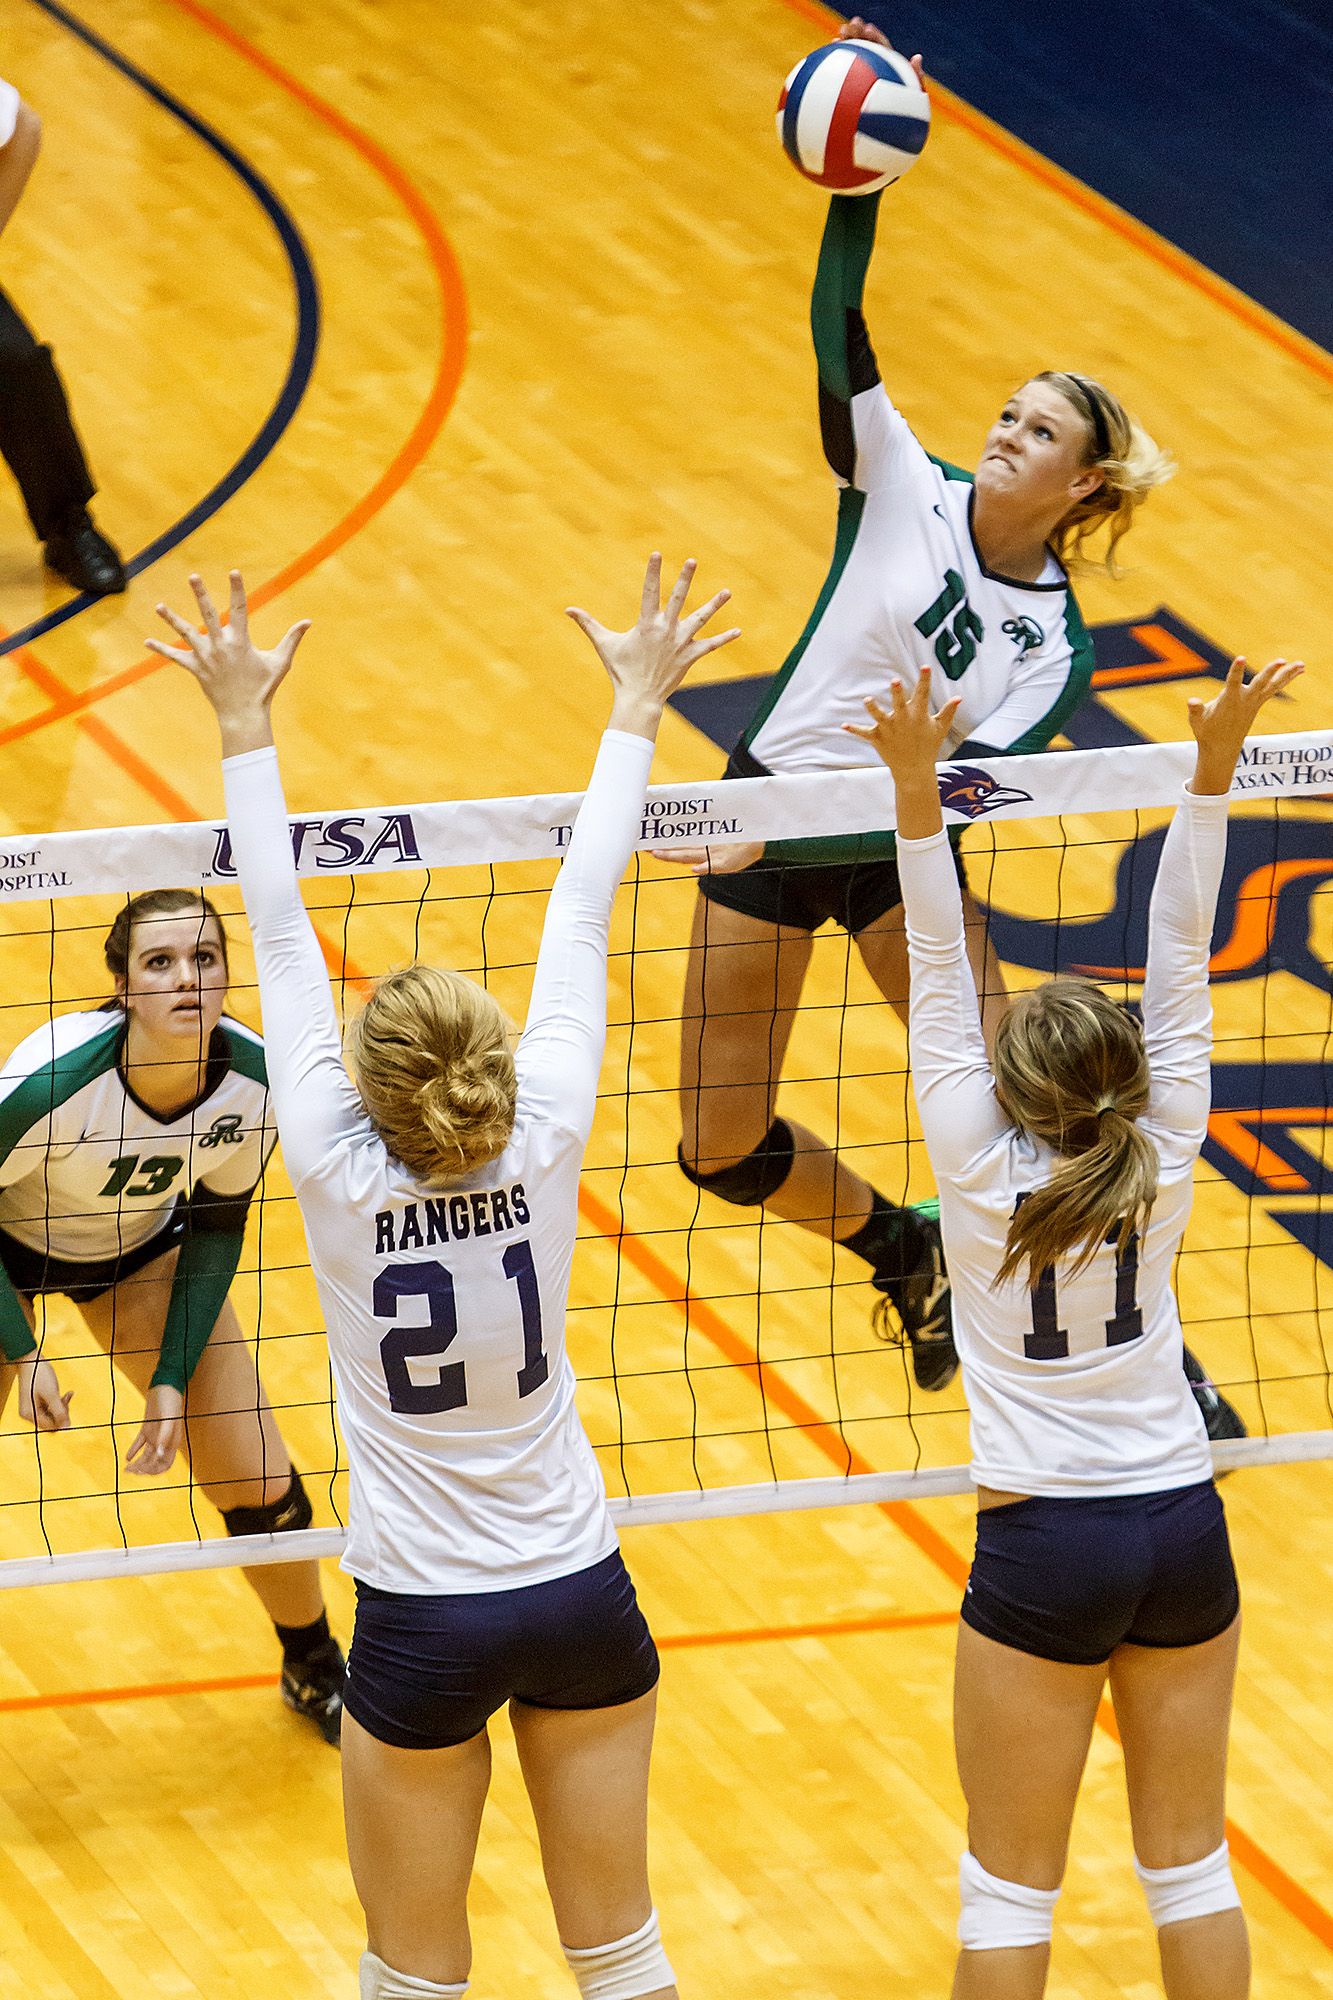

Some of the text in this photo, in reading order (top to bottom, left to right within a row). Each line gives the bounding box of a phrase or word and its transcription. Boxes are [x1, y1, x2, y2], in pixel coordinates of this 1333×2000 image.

[914, 568, 984, 682] 15
[1231, 764, 1333, 790] XSAN HOS
[1236, 744, 1333, 768] METHOD
[638, 818, 744, 841] HOSPITAL
[0, 870, 73, 892] SPITAL
[97, 1153, 184, 1196] 13
[374, 1183, 531, 1255] RANGERS
[1022, 1216, 1144, 1361] 11
[372, 1239, 549, 1415] 21
